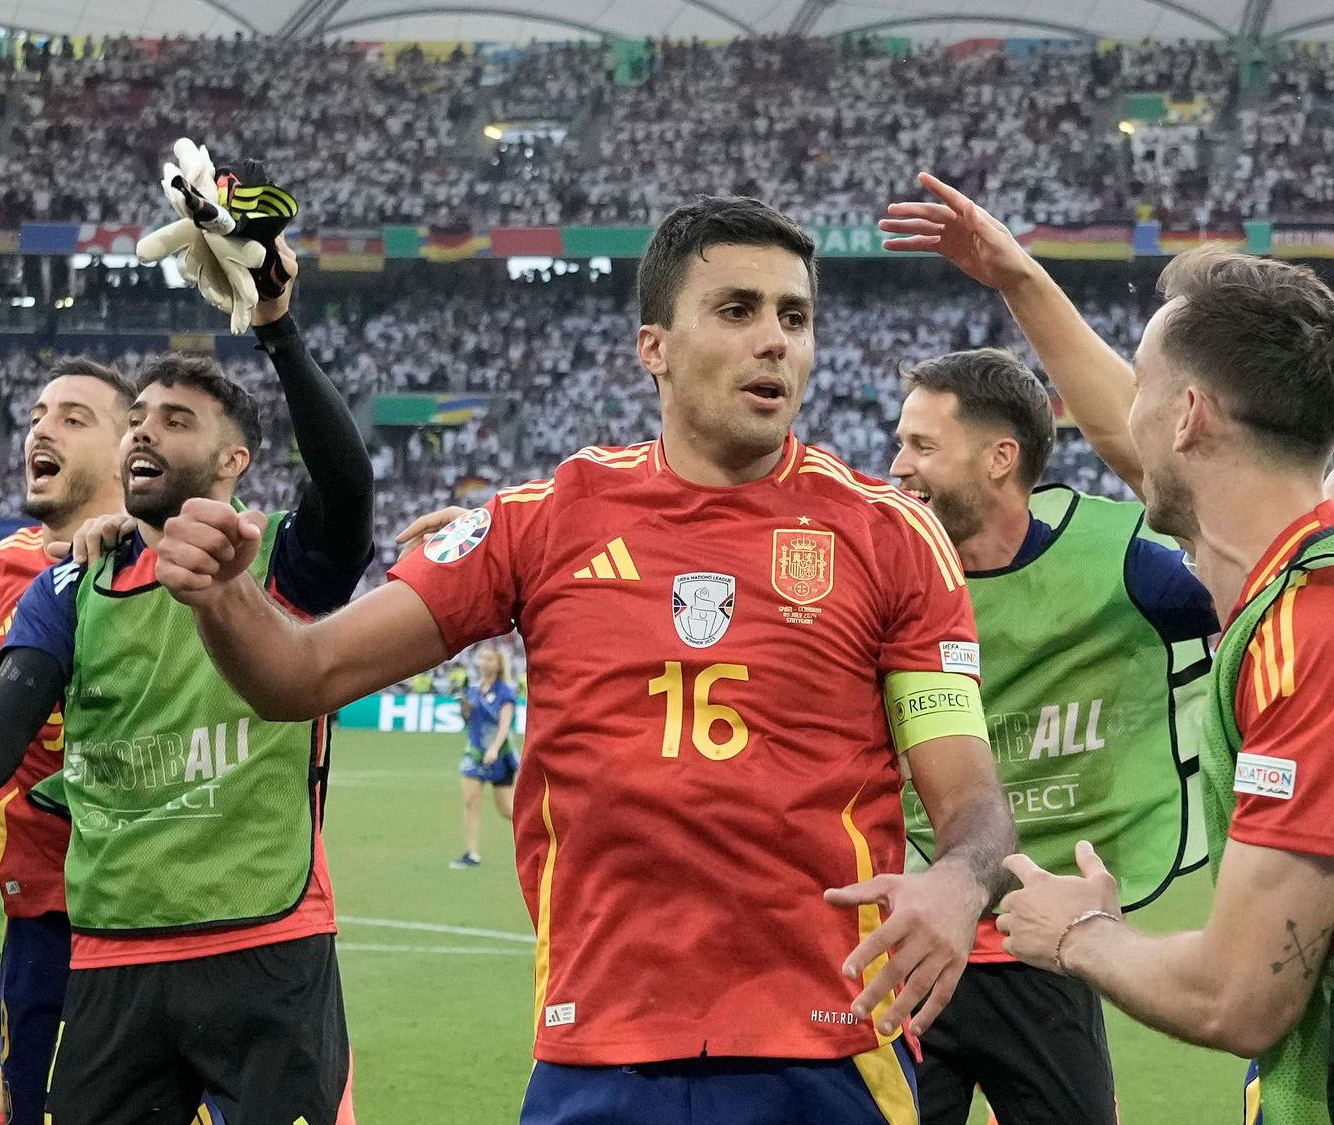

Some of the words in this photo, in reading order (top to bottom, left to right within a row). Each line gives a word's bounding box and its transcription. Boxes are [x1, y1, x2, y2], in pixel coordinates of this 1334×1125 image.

[379, 693, 466, 733] His
[649, 661, 750, 761] 16
[909, 693, 971, 713] RESPECT
